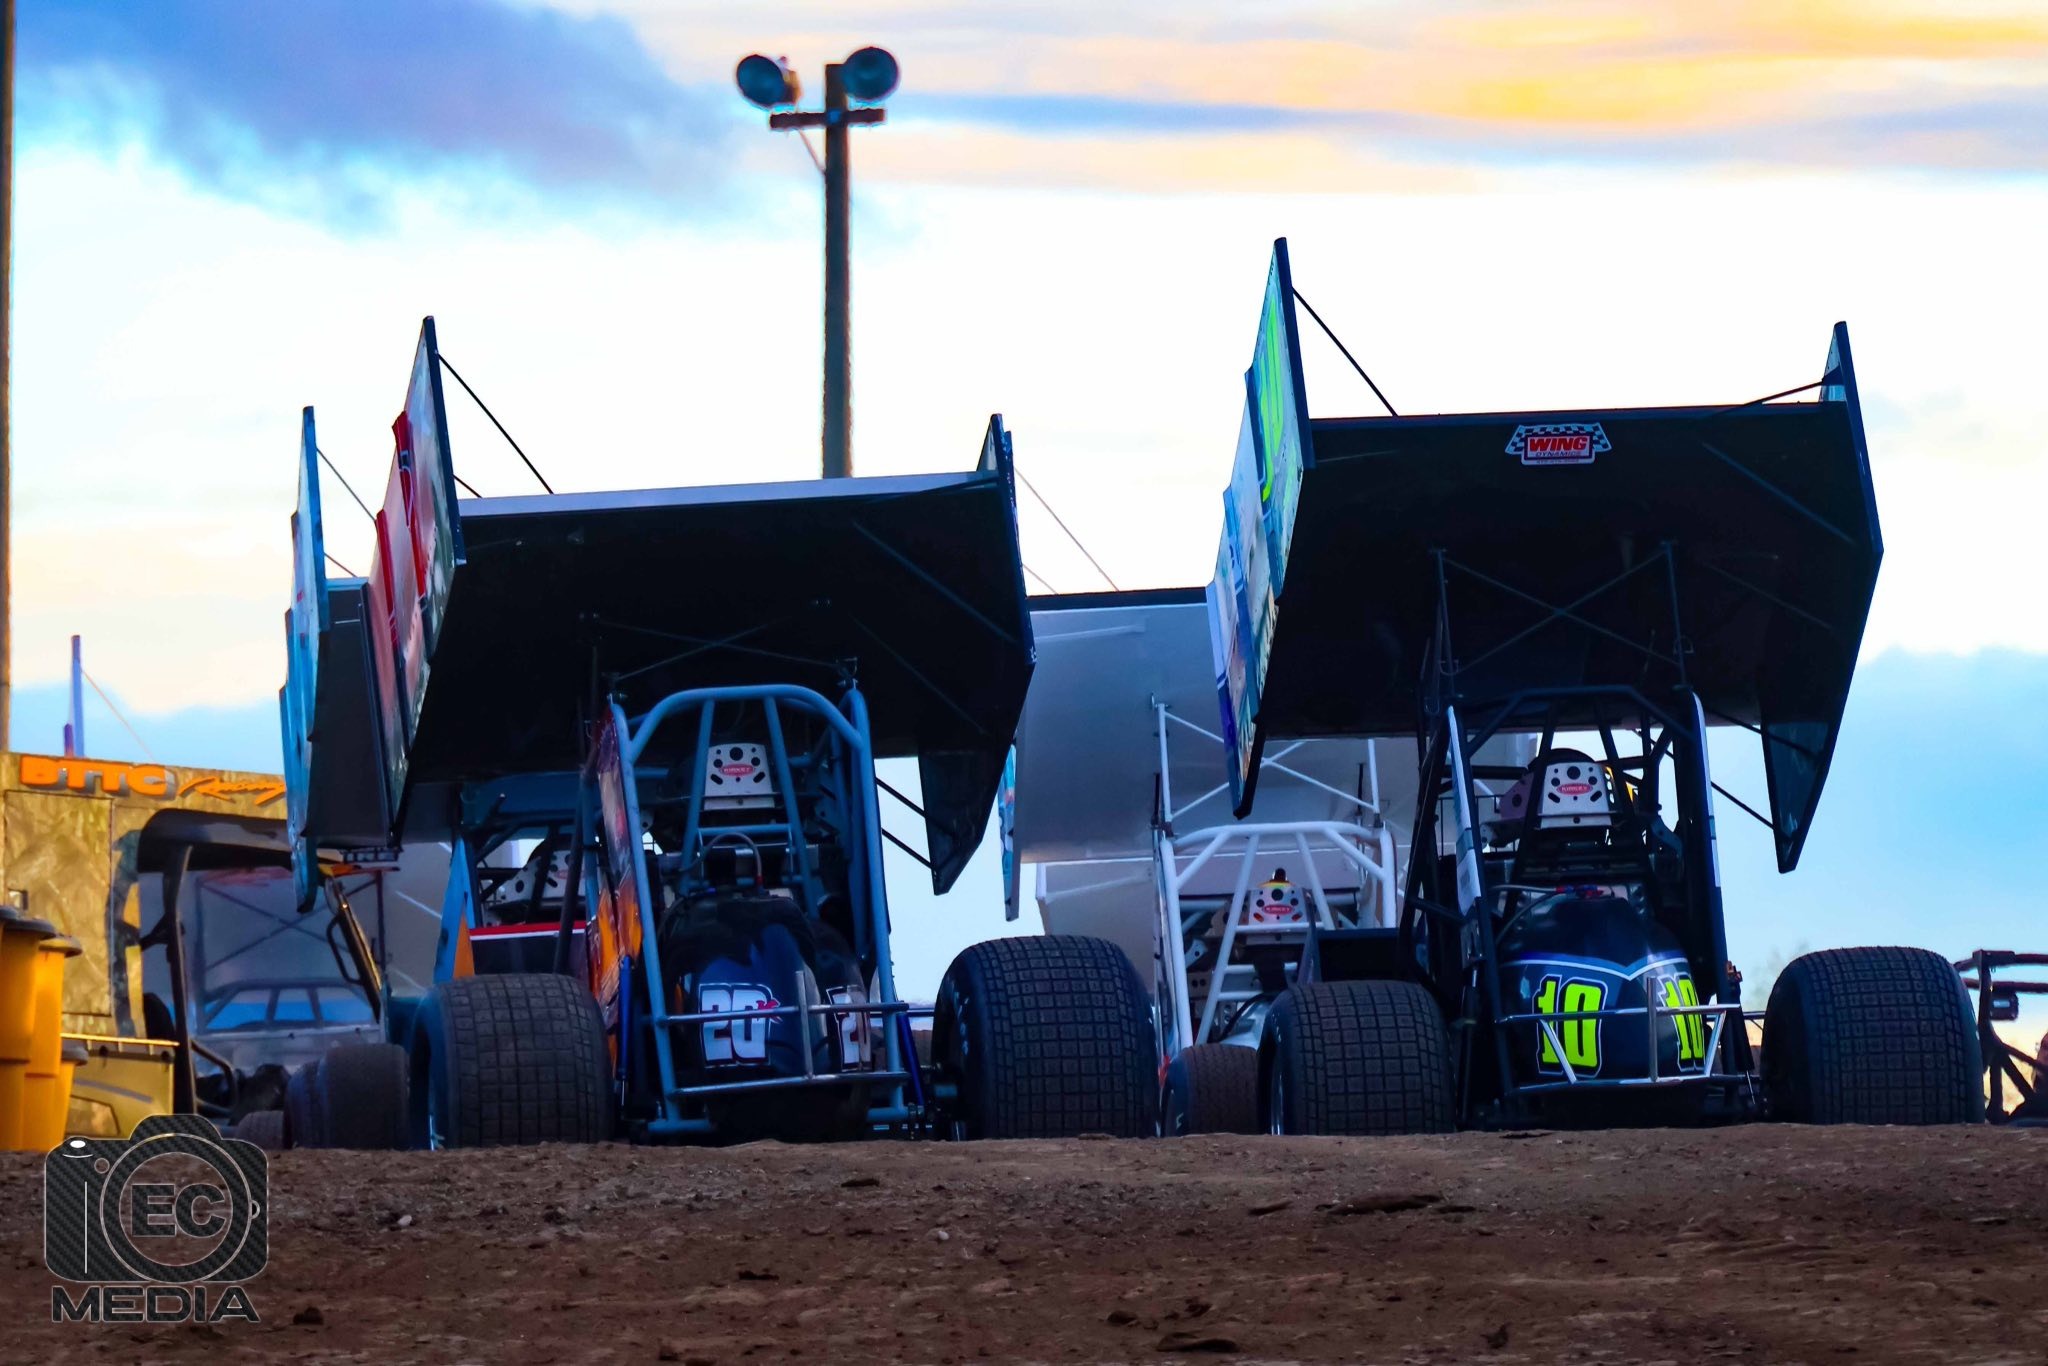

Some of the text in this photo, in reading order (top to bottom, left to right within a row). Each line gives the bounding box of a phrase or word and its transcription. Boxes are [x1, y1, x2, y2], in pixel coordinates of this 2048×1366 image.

[1529, 436, 1588, 452] WING
[1533, 975, 1606, 1076] 10
[1659, 973, 1706, 1070] 10
